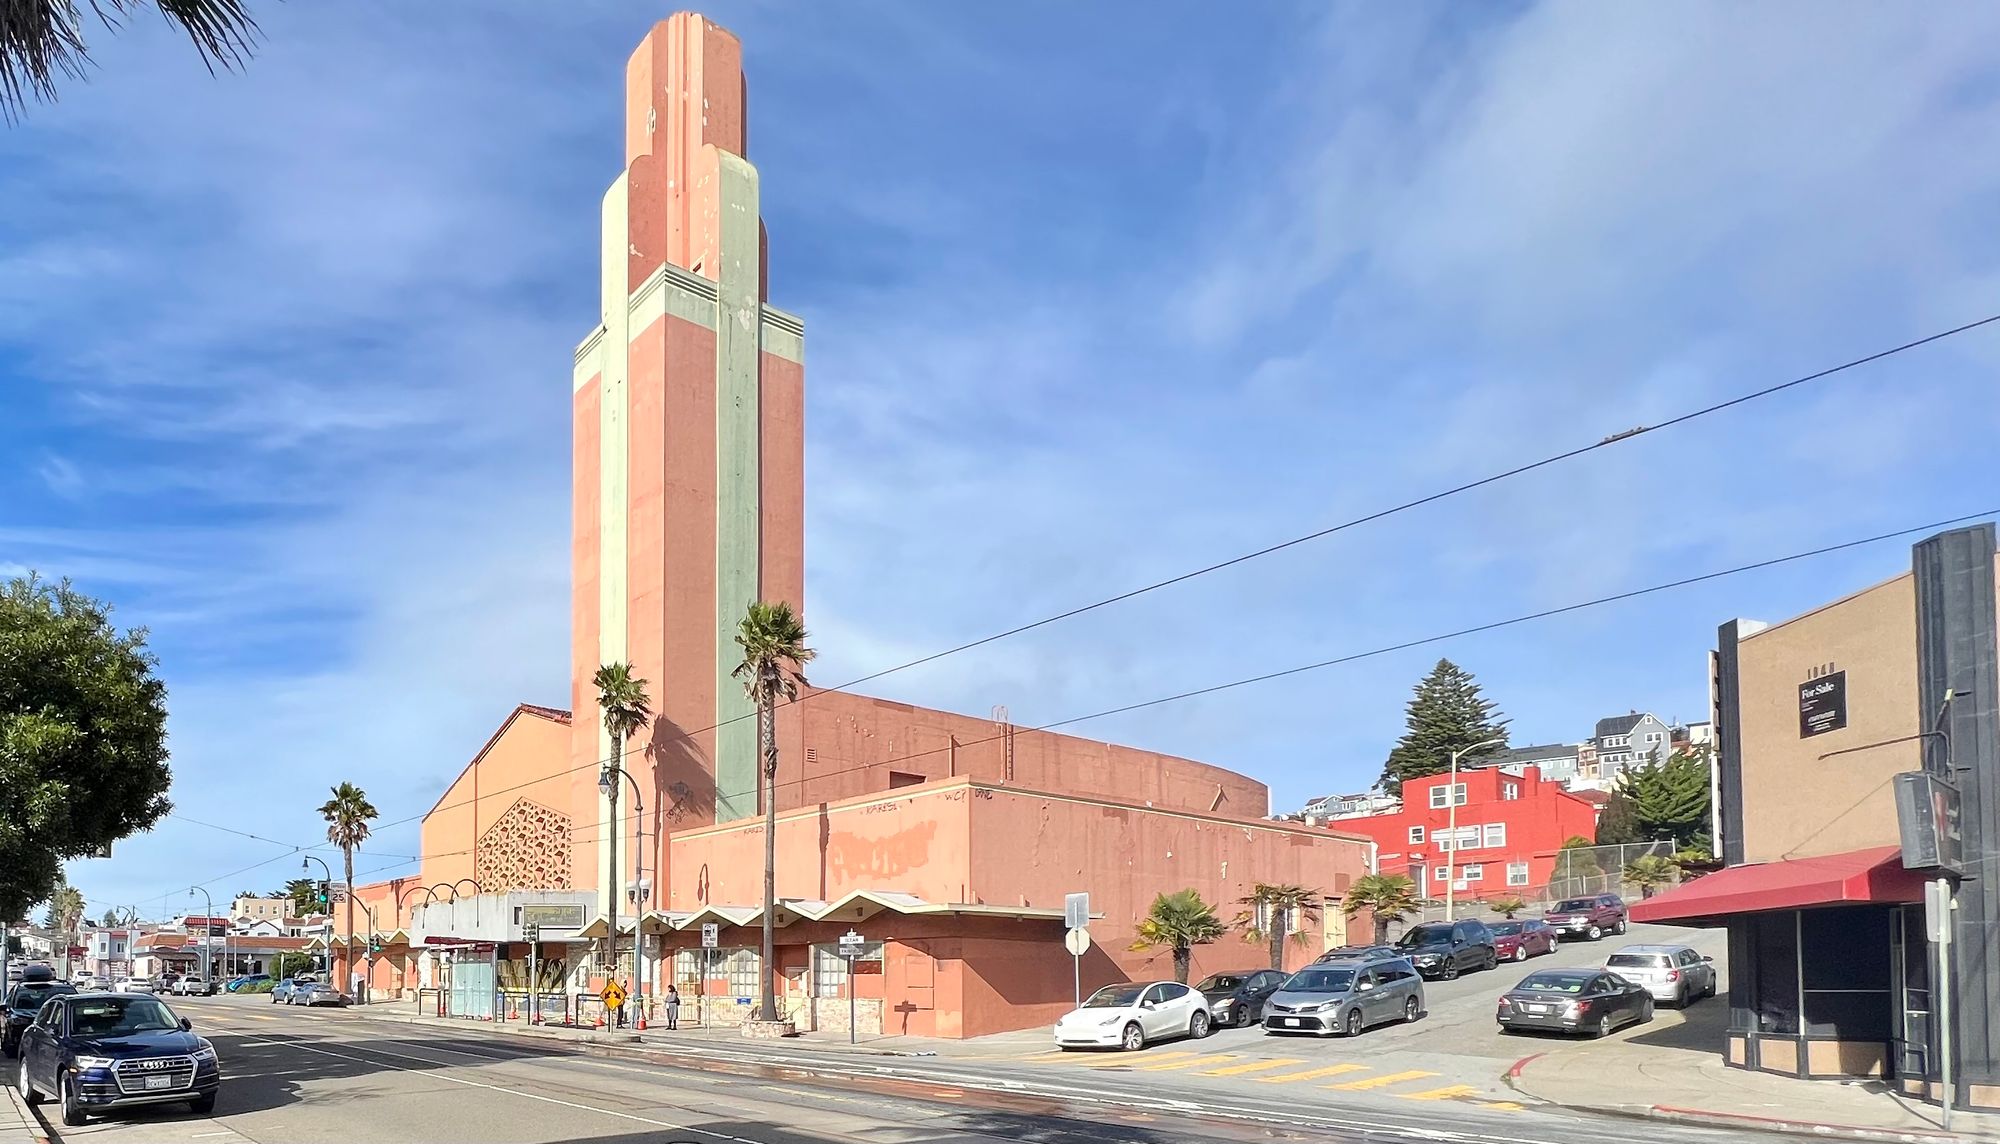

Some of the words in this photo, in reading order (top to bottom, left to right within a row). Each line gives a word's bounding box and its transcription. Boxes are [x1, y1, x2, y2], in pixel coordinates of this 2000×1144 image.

[1802, 688, 1815, 699] For
[1815, 682, 1835, 695] Sale
[332, 893, 345, 901] 25
